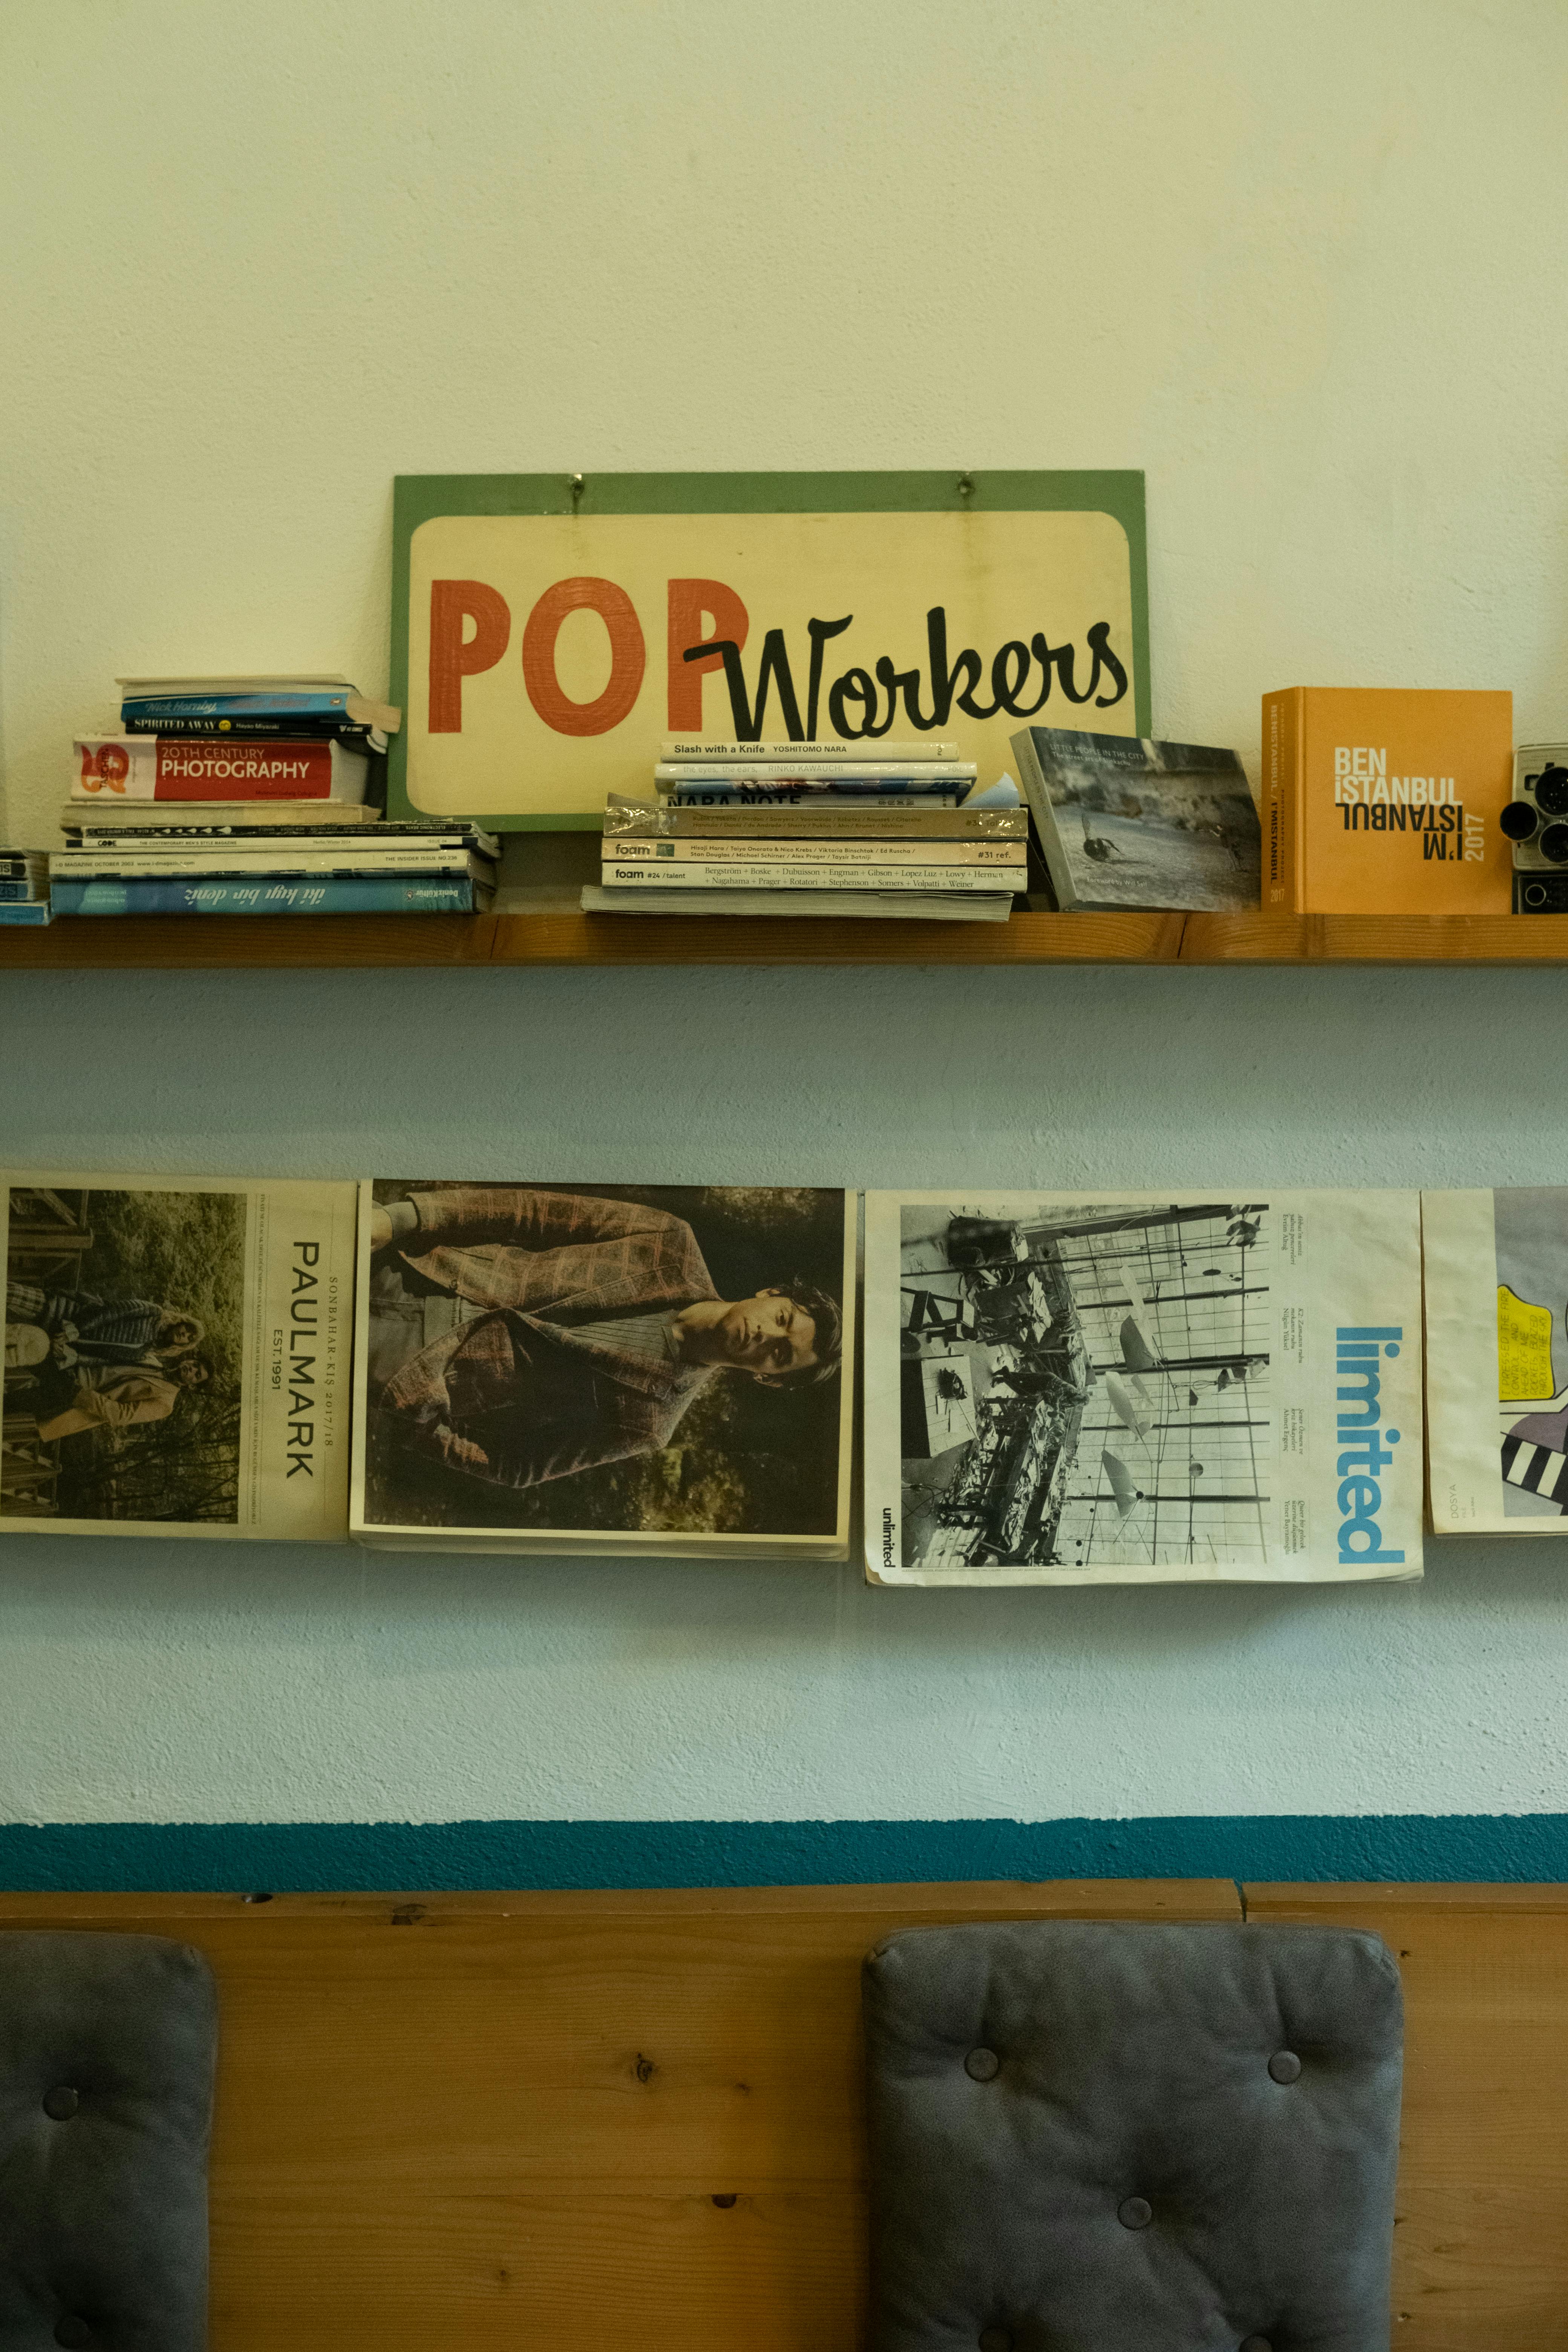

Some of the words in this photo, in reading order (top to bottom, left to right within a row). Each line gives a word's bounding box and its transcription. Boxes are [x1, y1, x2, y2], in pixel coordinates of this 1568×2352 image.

[428, 577, 749, 737] POP
[682, 606, 1128, 742] Workers
[134, 720, 184, 729] SPIRITED
[188, 720, 216, 730] AWAY
[162, 747, 200, 759] 20TH
[204, 748, 264, 760] CENTURY
[674, 744, 701, 753] Slash
[705, 745, 727, 753] with
[739, 745, 765, 753] Knife
[1050, 744, 1073, 752] LITTLE
[100, 747, 110, 789] TASCHEN
[161, 760, 310, 778] PHOTOGRAPHY
[1335, 747, 1386, 776] BEN
[1335, 803, 1462, 832] ISTANBUL
[1424, 833, 1462, 861] I'M
[1465, 813, 1484, 862] 2017
[616, 844, 651, 855] foam
[616, 869, 644, 879] foam
[705, 867, 741, 876] Bergström
[829, 869, 859, 877] Engman
[902, 870, 922, 878] Lopez
[946, 870, 965, 879] Lowy
[758, 878, 781, 886] Prager
[913, 880, 940, 888] Volpatti
[184, 889, 227, 905] deniz
[233, 889, 260, 905] bir
[302, 889, 326, 904] iki
[1270, 888, 1285, 902] 2017
[1501, 1289, 1509, 1310] FIRE
[1501, 1315, 1509, 1331] THE
[1510, 1323, 1519, 1341] AND
[1530, 1315, 1538, 1350] BLAZED
[1539, 1316, 1547, 1332] SKY
[1520, 1332, 1529, 1346] ME
[1539, 1336, 1547, 1352] THE
[286, 1241, 320, 1478] PAULMARK
[1501, 1338, 1510, 1386] PRESSED
[1520, 1350, 1528, 1364] OF
[1511, 1354, 1520, 1396] CONTROL
[1520, 1367, 1529, 1396] AHEAD
[1530, 1357, 1538, 1396] ROCKETS
[1539, 1356, 1548, 1396] THROUGH
[324, 1393, 333, 1446] 2017/18
[1336, 1327, 1405, 1564] limited
[1449, 1484, 1459, 1519] DOSYA
[883, 1508, 896, 1568] unlimited
